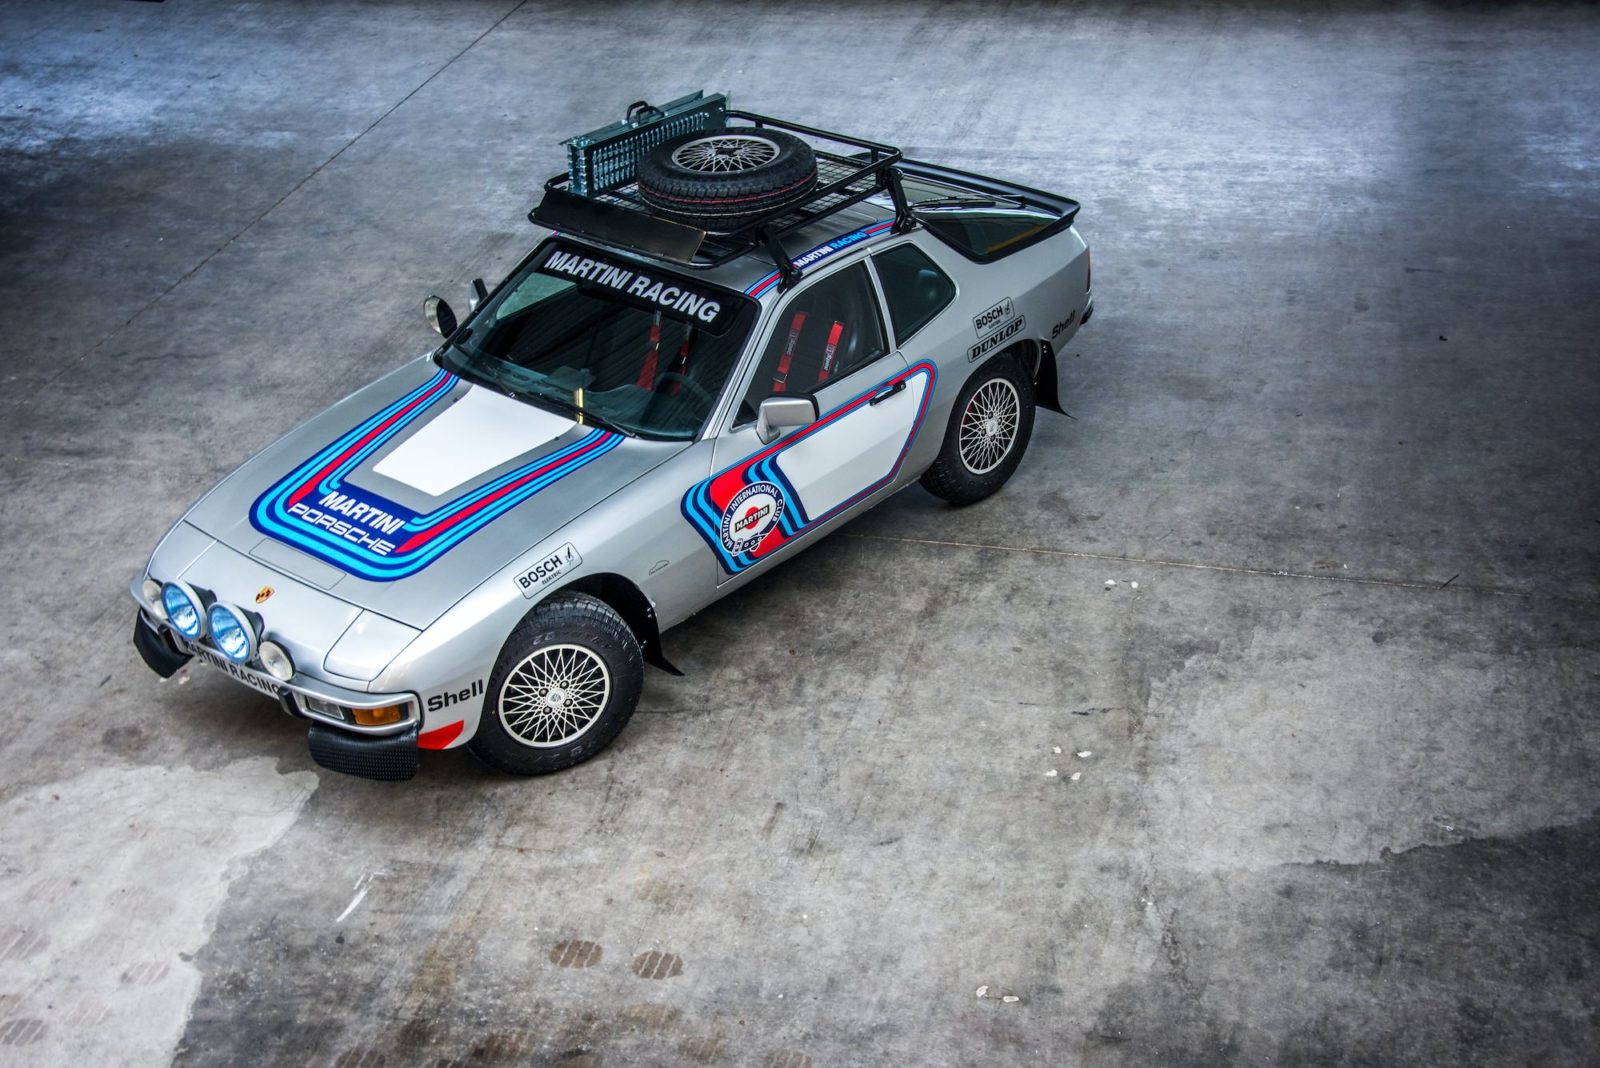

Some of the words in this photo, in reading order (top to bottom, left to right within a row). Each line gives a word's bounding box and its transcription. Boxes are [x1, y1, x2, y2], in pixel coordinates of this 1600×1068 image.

[793, 245, 834, 268] MARTINI
[830, 230, 867, 250] RACING
[543, 251, 633, 290] MARTINI
[626, 275, 721, 323] RACING
[975, 305, 1003, 330] BOSCH
[1051, 309, 1076, 339] Shell
[971, 318, 1023, 360] DUNLOP
[287, 502, 396, 556] PORSCHE
[318, 490, 406, 535] MARTINI
[722, 513, 734, 548] MARTINI
[730, 484, 779, 512] INTERNATIONAL
[735, 505, 769, 531] MARTINI
[518, 555, 563, 589] BOSCH
[427, 679, 484, 713] Shell
